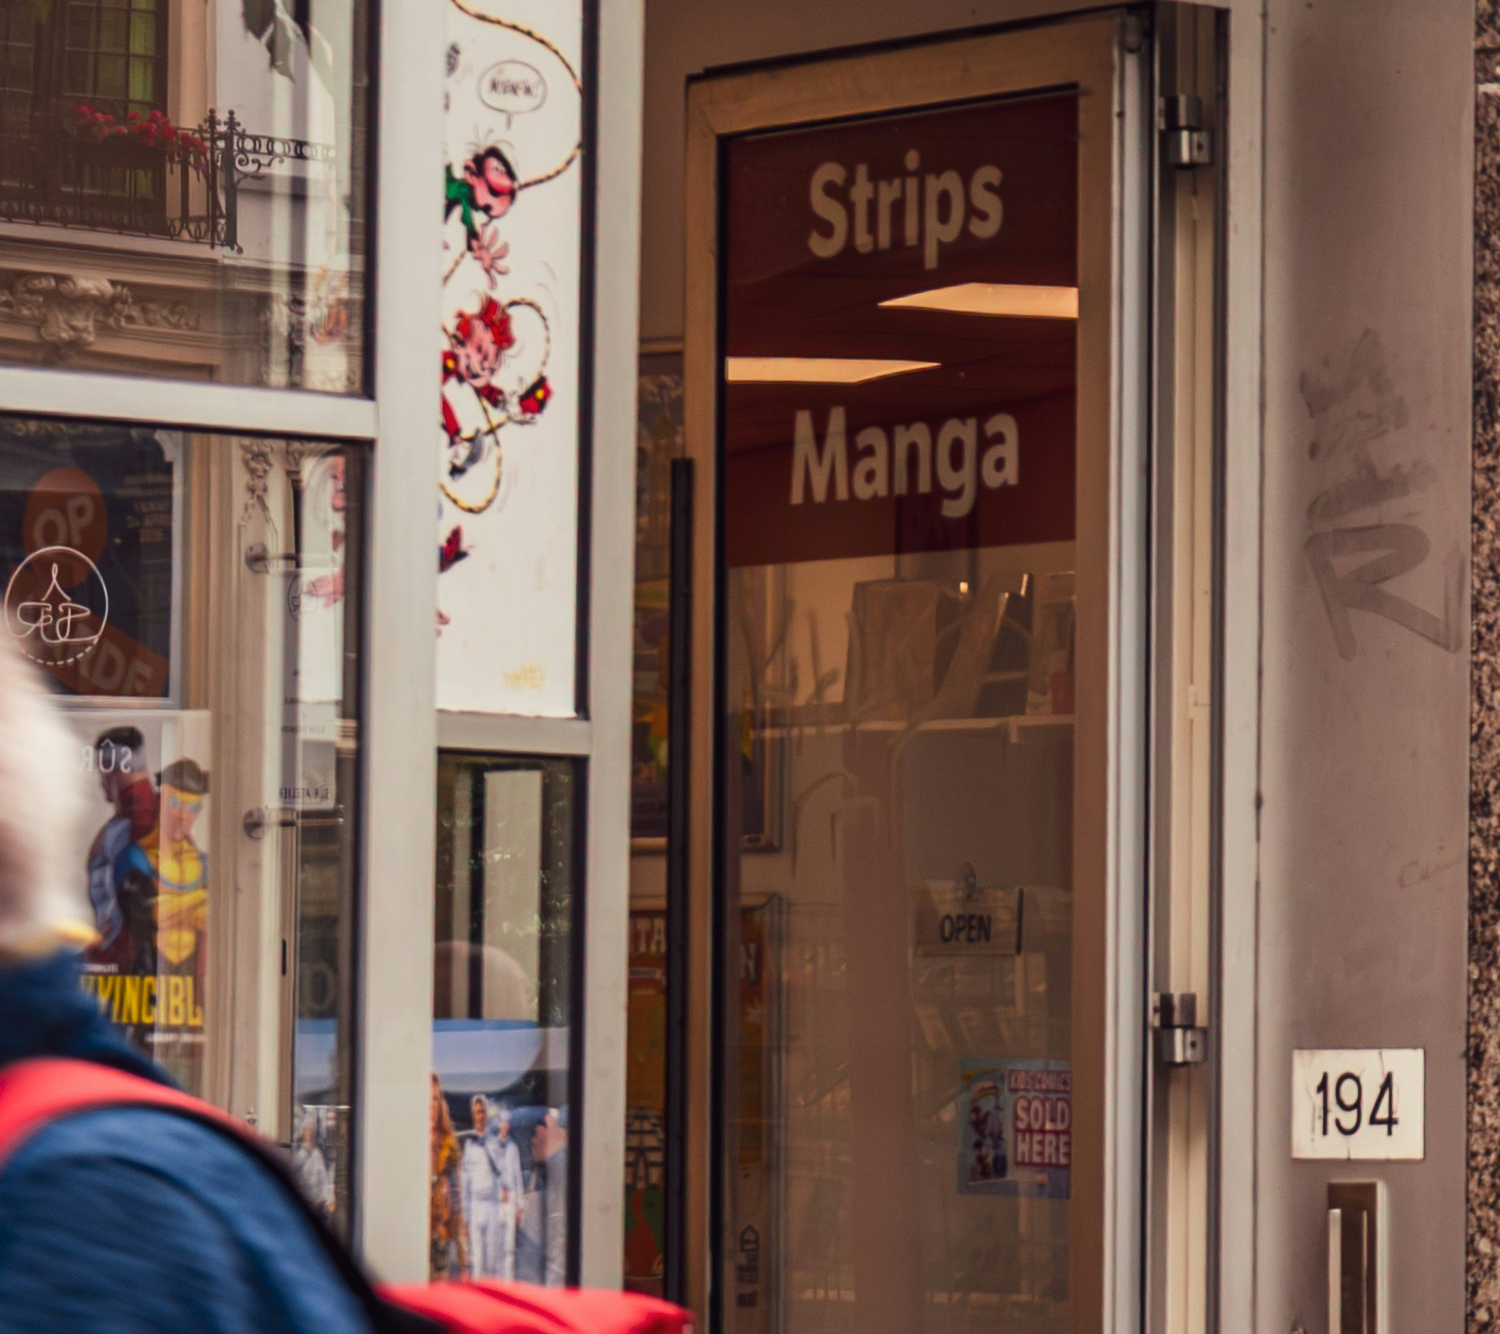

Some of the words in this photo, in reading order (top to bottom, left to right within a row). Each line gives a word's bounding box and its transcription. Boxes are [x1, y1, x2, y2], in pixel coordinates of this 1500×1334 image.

[807, 152, 1005, 268] Strips
[790, 407, 1020, 521] Manga
[939, 912, 992, 944] OPEN
[1015, 1097, 1070, 1130] SOLD
[1313, 1071, 1401, 1138] 194
[1016, 1131, 1070, 1164] HERE
